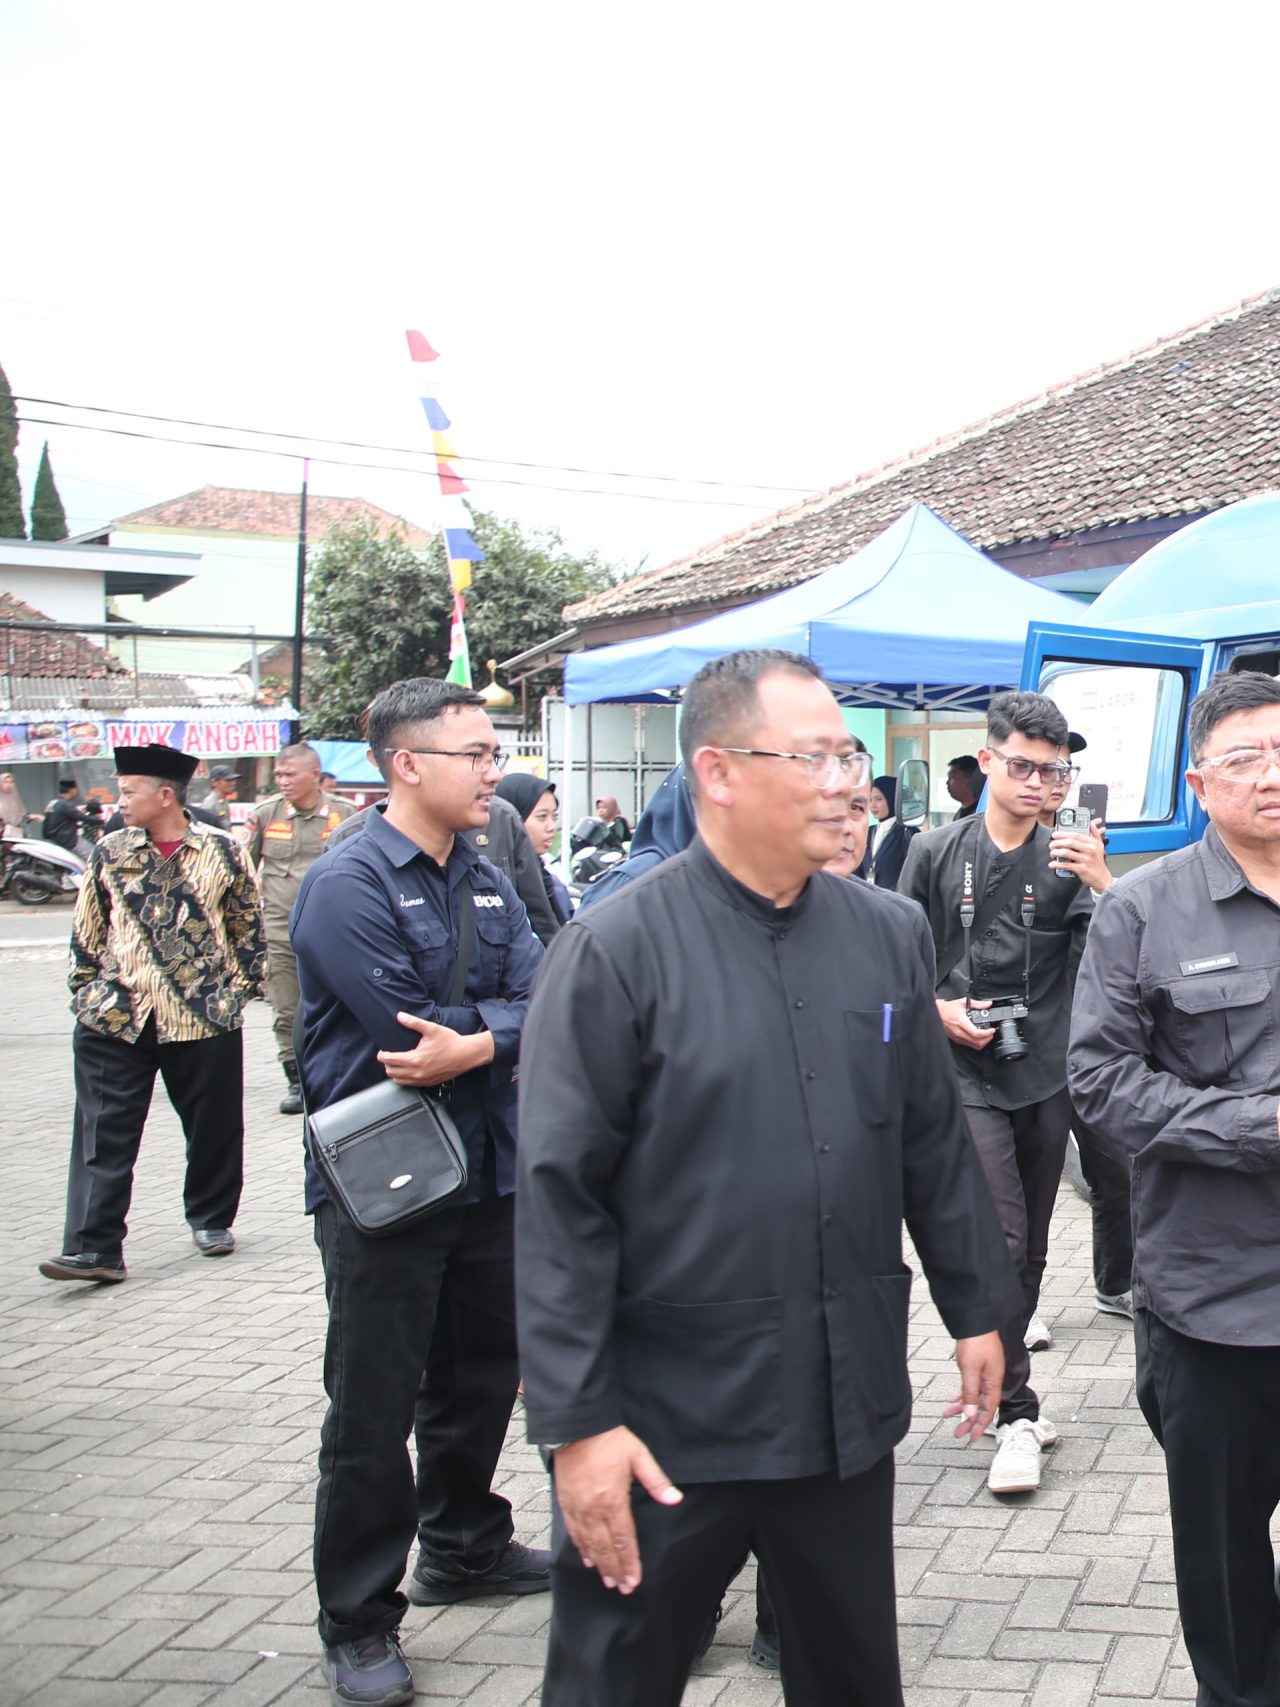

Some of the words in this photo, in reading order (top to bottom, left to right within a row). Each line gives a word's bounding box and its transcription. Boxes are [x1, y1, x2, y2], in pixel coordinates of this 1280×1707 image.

[108, 724, 173, 750] MAK
[184, 723, 278, 752] ANGAH
[963, 861, 973, 895] SONY
